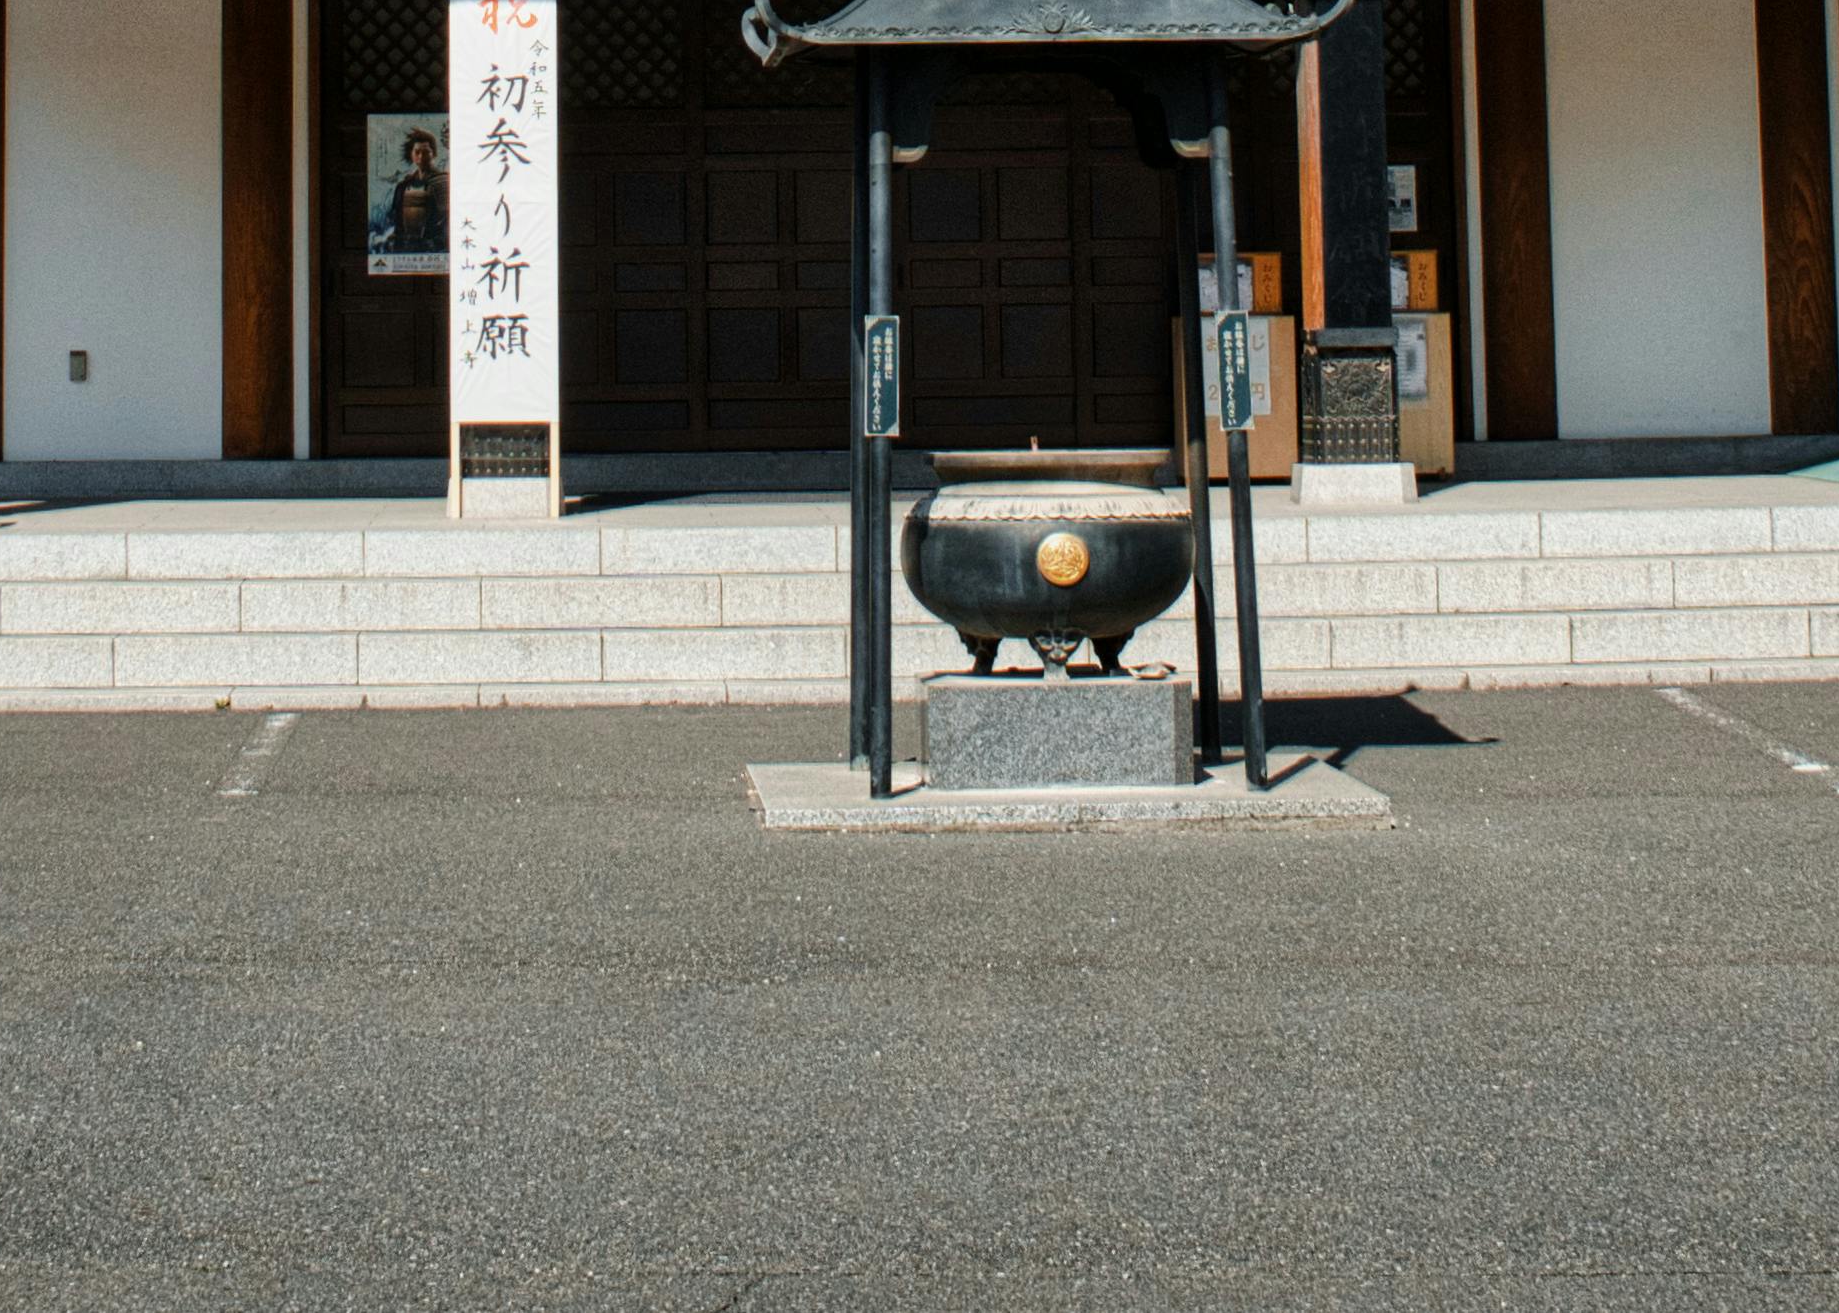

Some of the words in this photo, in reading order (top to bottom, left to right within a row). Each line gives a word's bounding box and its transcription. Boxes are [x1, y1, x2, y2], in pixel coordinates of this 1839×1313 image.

[528, 39, 550, 120] 令和五年
[475, 63, 532, 360] 初参り祈願
[459, 216, 478, 370] 大本山増上寺
[1263, 263, 1273, 304] おみくじ
[1418, 262, 1427, 302] おみくじ
